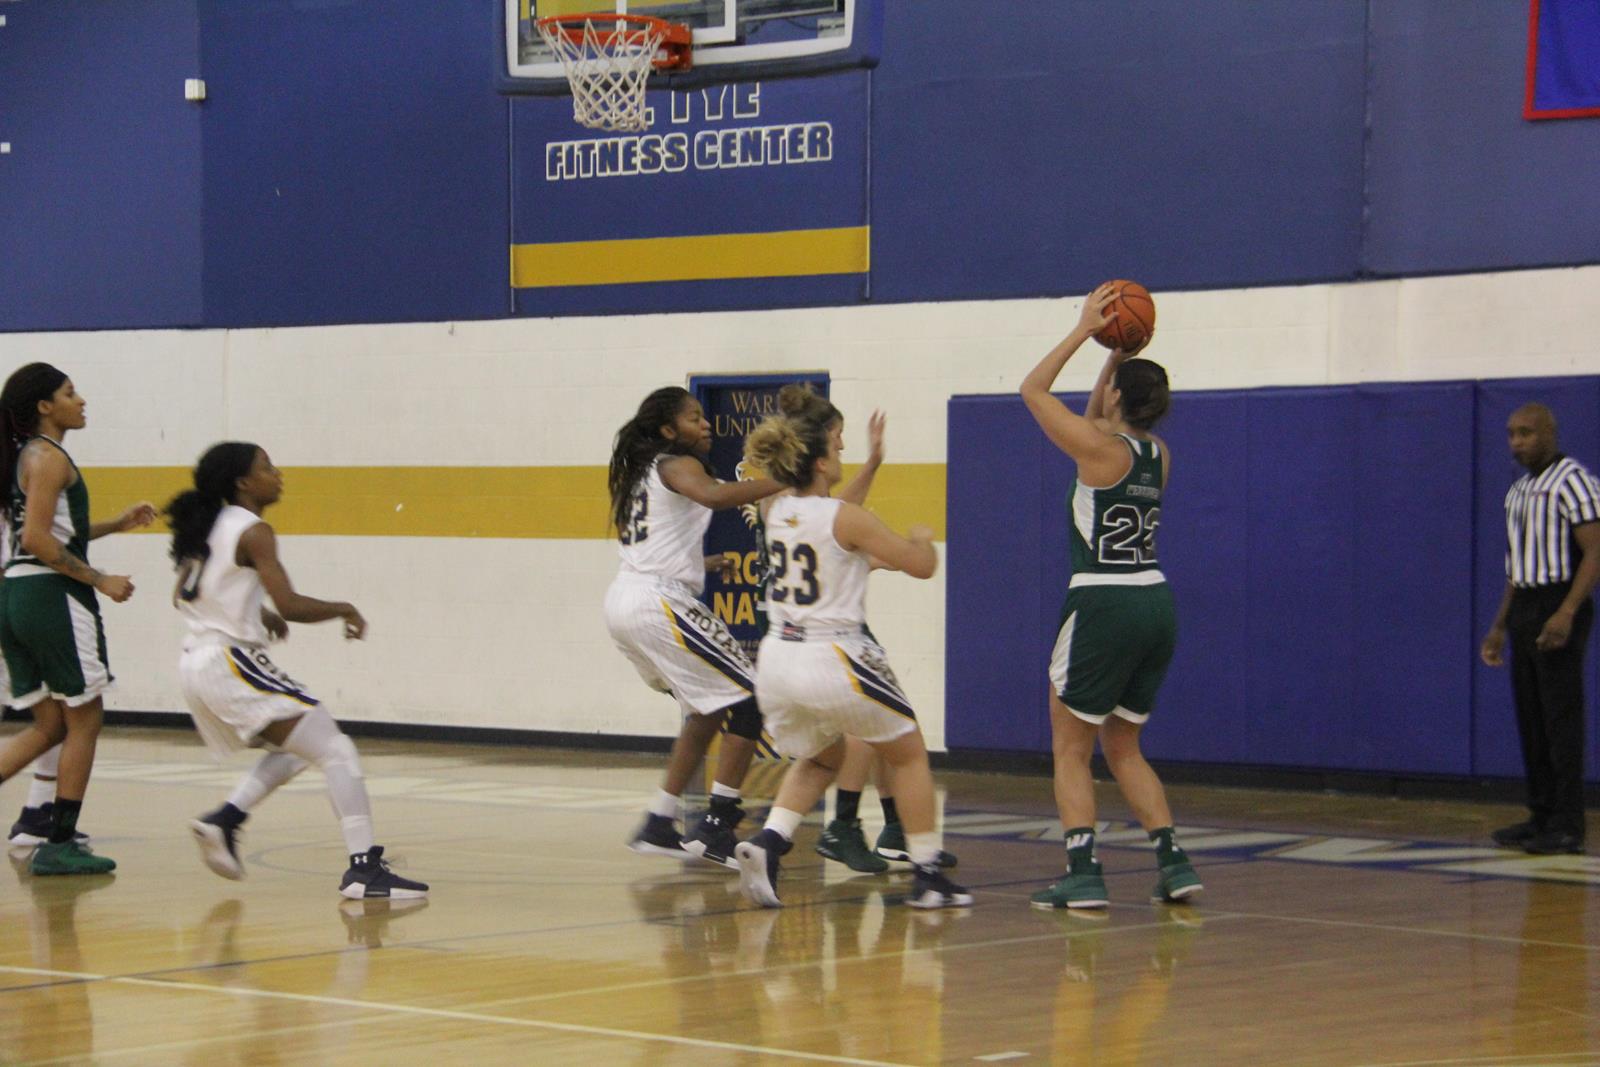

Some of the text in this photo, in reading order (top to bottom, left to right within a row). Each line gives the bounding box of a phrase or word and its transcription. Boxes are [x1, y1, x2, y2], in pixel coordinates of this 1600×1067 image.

[546, 122, 832, 181] FITNESS CENTER
[731, 391, 781, 415] WAR
[769, 539, 820, 607] 23
[713, 591, 758, 625] NA
